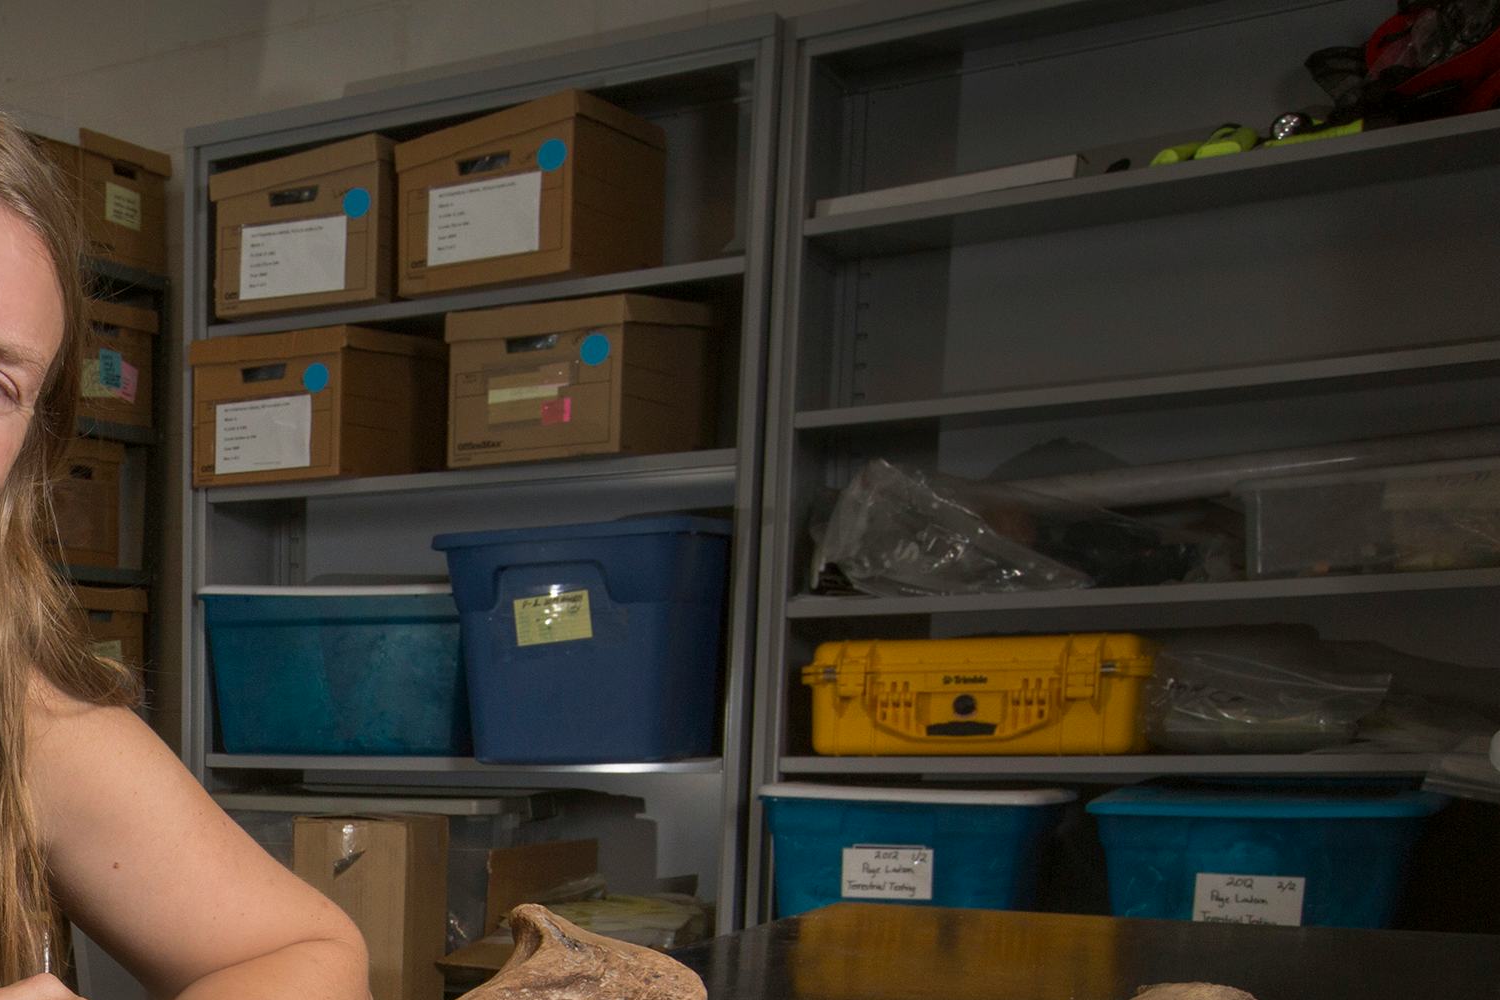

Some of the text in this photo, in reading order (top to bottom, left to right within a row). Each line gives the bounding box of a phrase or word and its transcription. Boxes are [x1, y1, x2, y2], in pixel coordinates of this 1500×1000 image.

[954, 675, 988, 684] Trimble
[874, 851, 899, 860] 2012
[1226, 877, 1296, 893] 2012 2/2
